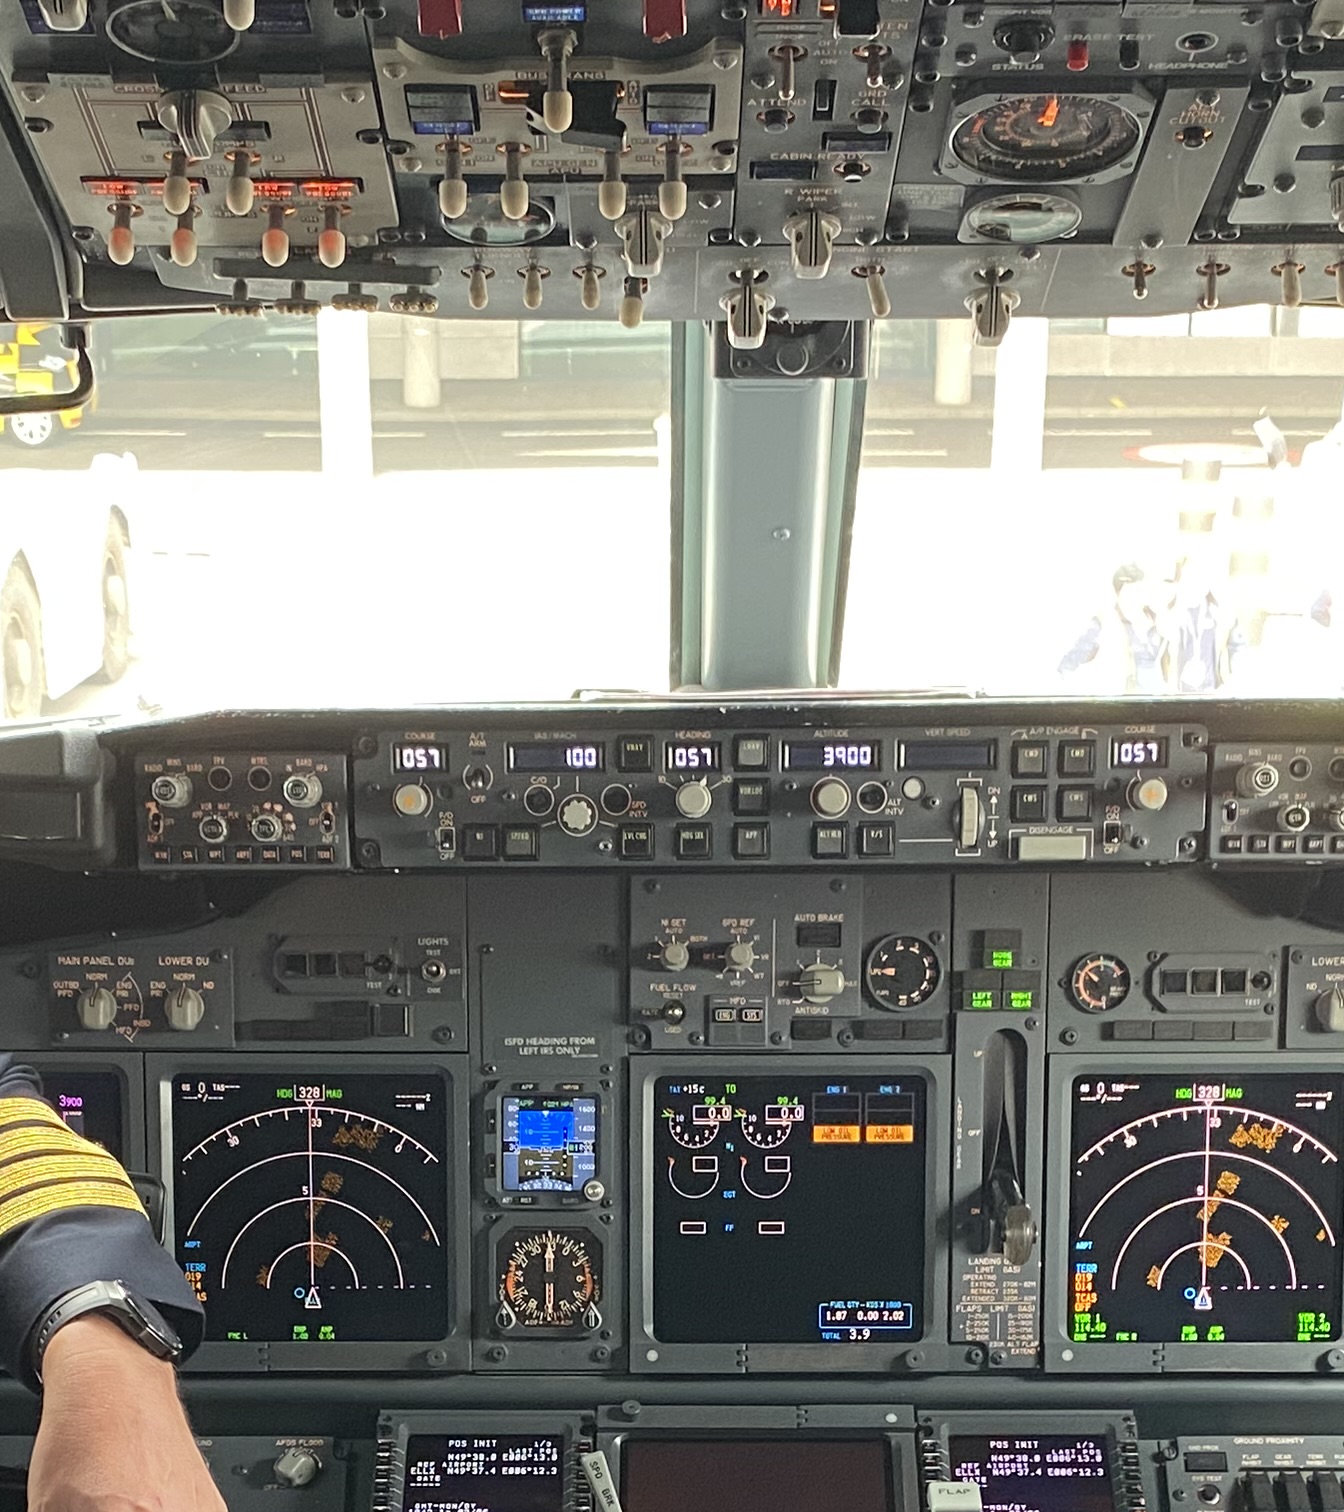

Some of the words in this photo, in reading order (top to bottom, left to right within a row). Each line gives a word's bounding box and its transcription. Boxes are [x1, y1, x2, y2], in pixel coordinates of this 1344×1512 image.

[814, 730, 848, 738] ALTITUDE
[1126, 726, 1155, 734] COURSE
[405, 732, 435, 741] COURSE
[675, 731, 711, 739] HEADING
[565, 747, 597, 766] 100
[675, 747, 712, 766] 057
[824, 747, 871, 765] 3900
[1120, 743, 1158, 762] 057
[403, 748, 439, 768] 057
[987, 839, 998, 848] UP
[794, 914, 815, 922] AUTO
[817, 914, 843, 922] BRAKE
[418, 938, 448, 946] LIGHTS
[58, 956, 79, 966] MAIN
[83, 956, 114, 966] PANEL
[159, 956, 194, 966] LOWER
[198, 956, 209, 966] DU
[1312, 957, 1342, 966] LOWER
[86, 973, 108, 981] NORM
[173, 973, 195, 981] NORM
[299, 1086, 320, 1098] 328
[726, 1084, 736, 1093] TO
[1176, 1088, 1192, 1098] HDG
[1199, 1087, 1220, 1098] 328
[1226, 1088, 1243, 1098] MAG
[277, 1089, 292, 1098] HDG
[326, 1090, 342, 1098] MAG
[59, 1095, 82, 1107] 3900
[708, 1108, 729, 1119] 0.0
[781, 1108, 802, 1119] 0.0
[311, 1118, 322, 1127] 33
[1210, 1117, 1221, 1127] 33
[227, 1136, 239, 1147] 30
[185, 1263, 206, 1271] TERR
[1077, 1264, 1097, 1272] TERR
[1076, 1294, 1096, 1303] TCAS
[1075, 1303, 1091, 1312] OFF
[827, 1311, 847, 1320] 1.87
[857, 1311, 879, 1320] 0.00
[883, 1311, 904, 1320] 2.02
[1075, 1323, 1106, 1332] 114.40
[1298, 1323, 1330, 1332] 114.40
[849, 1329, 870, 1340] 3.9
[590, 1460, 602, 1479] SPD
[602, 1489, 614, 1507] BRK
